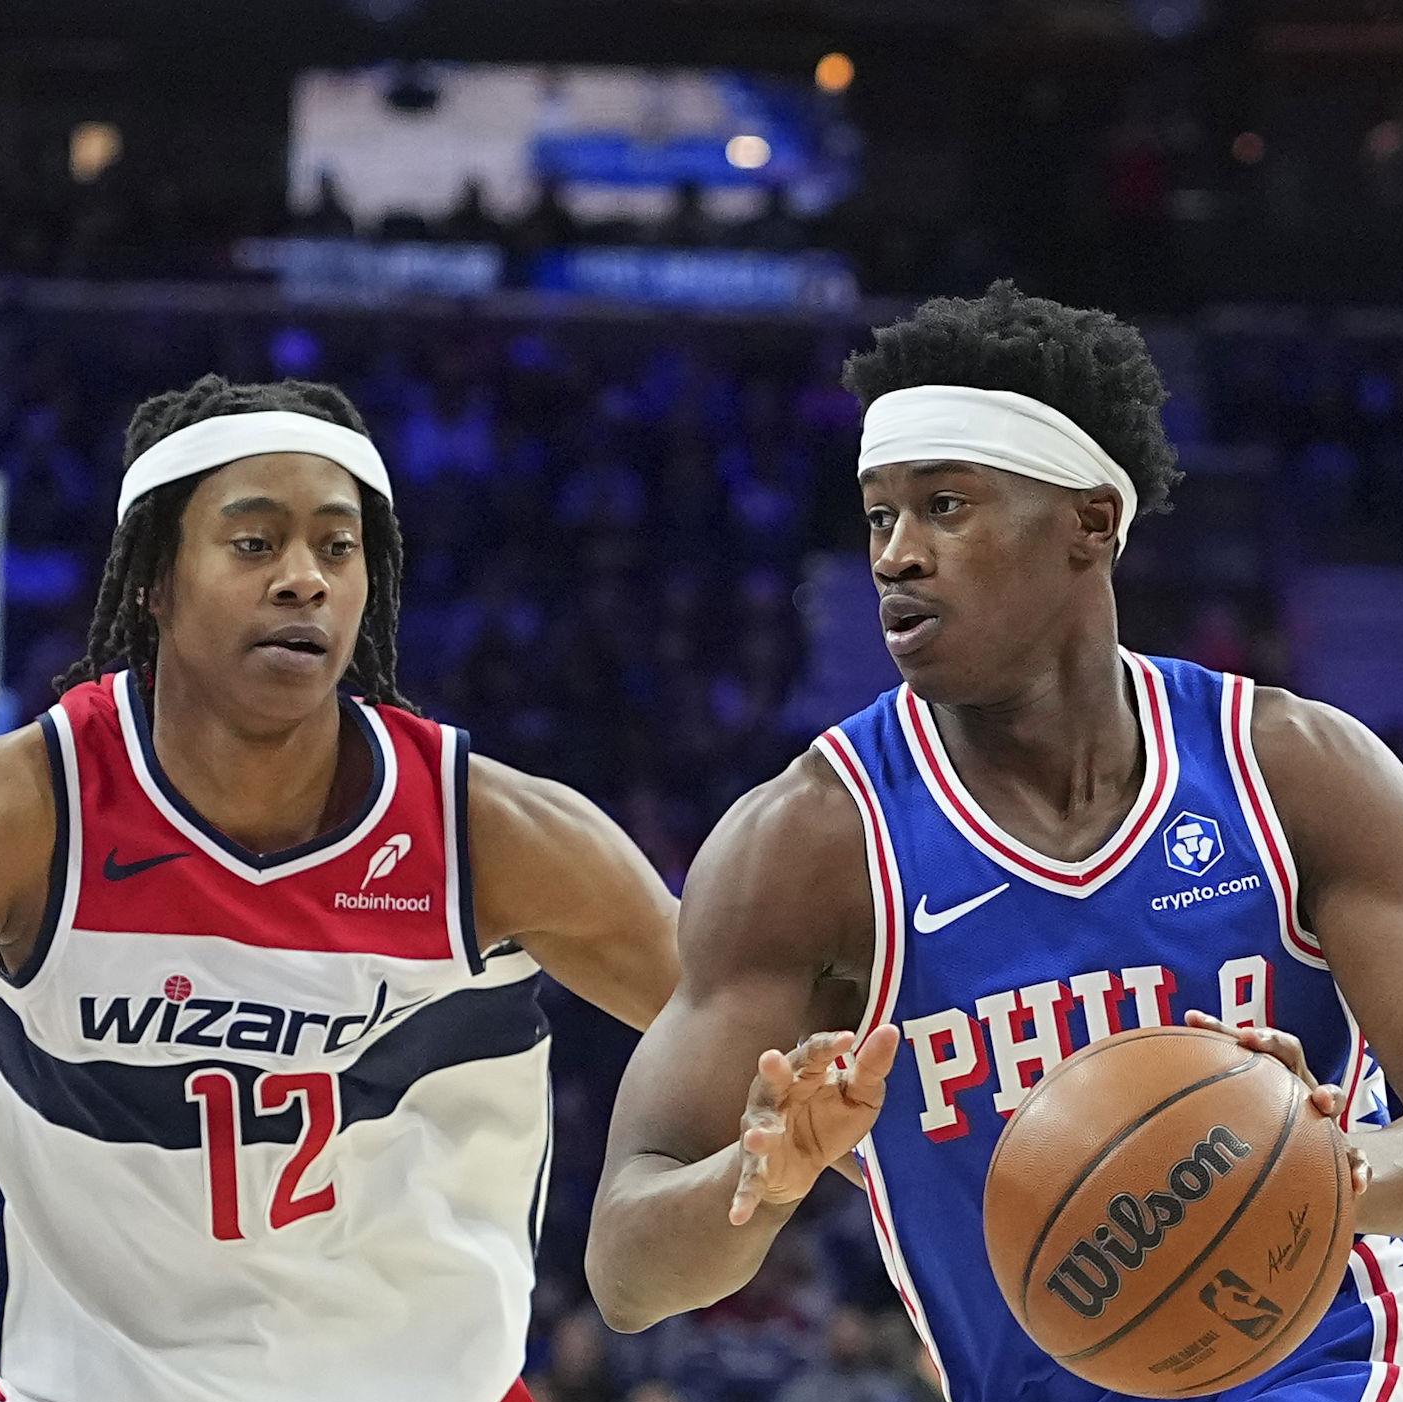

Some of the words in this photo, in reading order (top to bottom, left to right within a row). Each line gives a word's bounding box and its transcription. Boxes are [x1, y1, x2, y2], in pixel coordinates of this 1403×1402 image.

[334, 892, 430, 912] Robinhood
[1151, 875, 1260, 911] crypto.com
[185, 1067, 341, 1241] 12
[1045, 1125, 1253, 1319] Wilson
